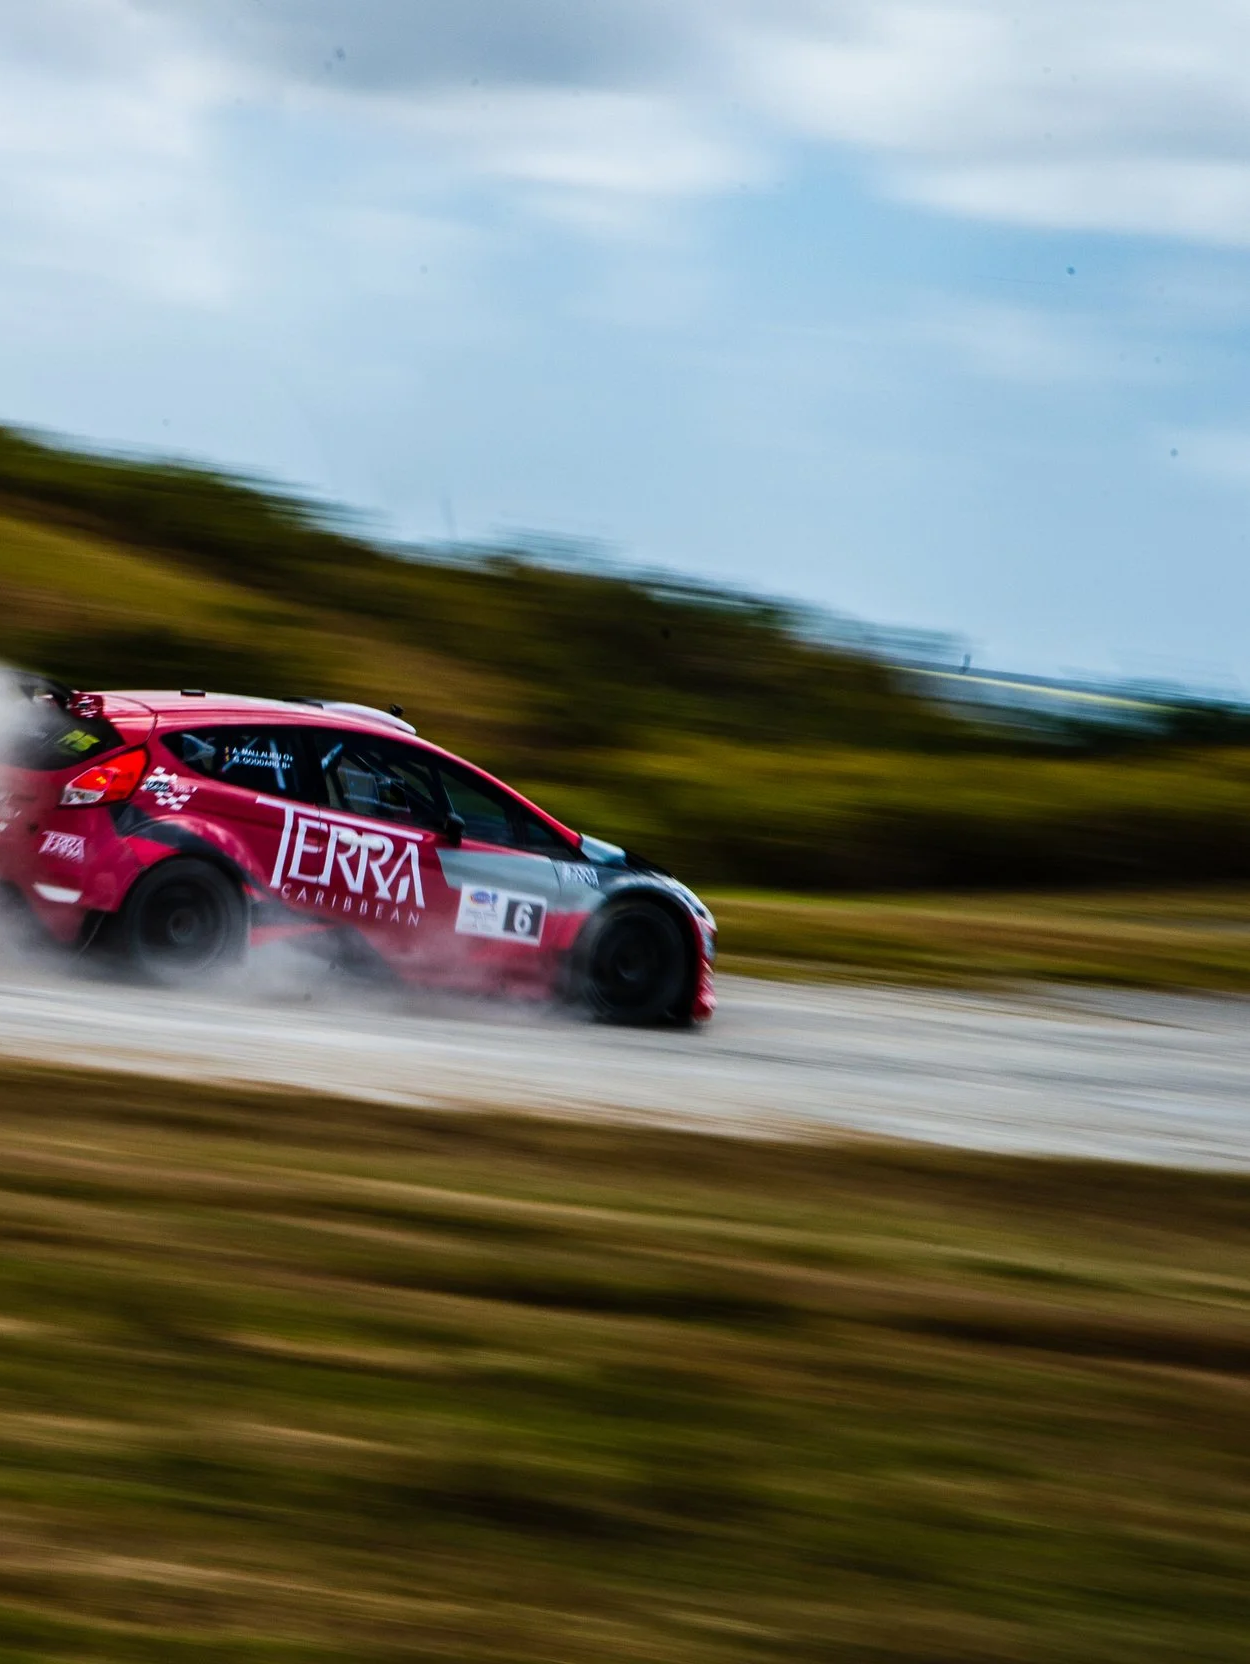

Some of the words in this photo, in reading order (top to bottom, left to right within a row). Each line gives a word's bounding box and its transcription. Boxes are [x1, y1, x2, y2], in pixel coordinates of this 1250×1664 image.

[256, 795, 425, 908] TERRA
[280, 883, 420, 927] CARIBBEAN
[514, 903, 532, 934] 6
